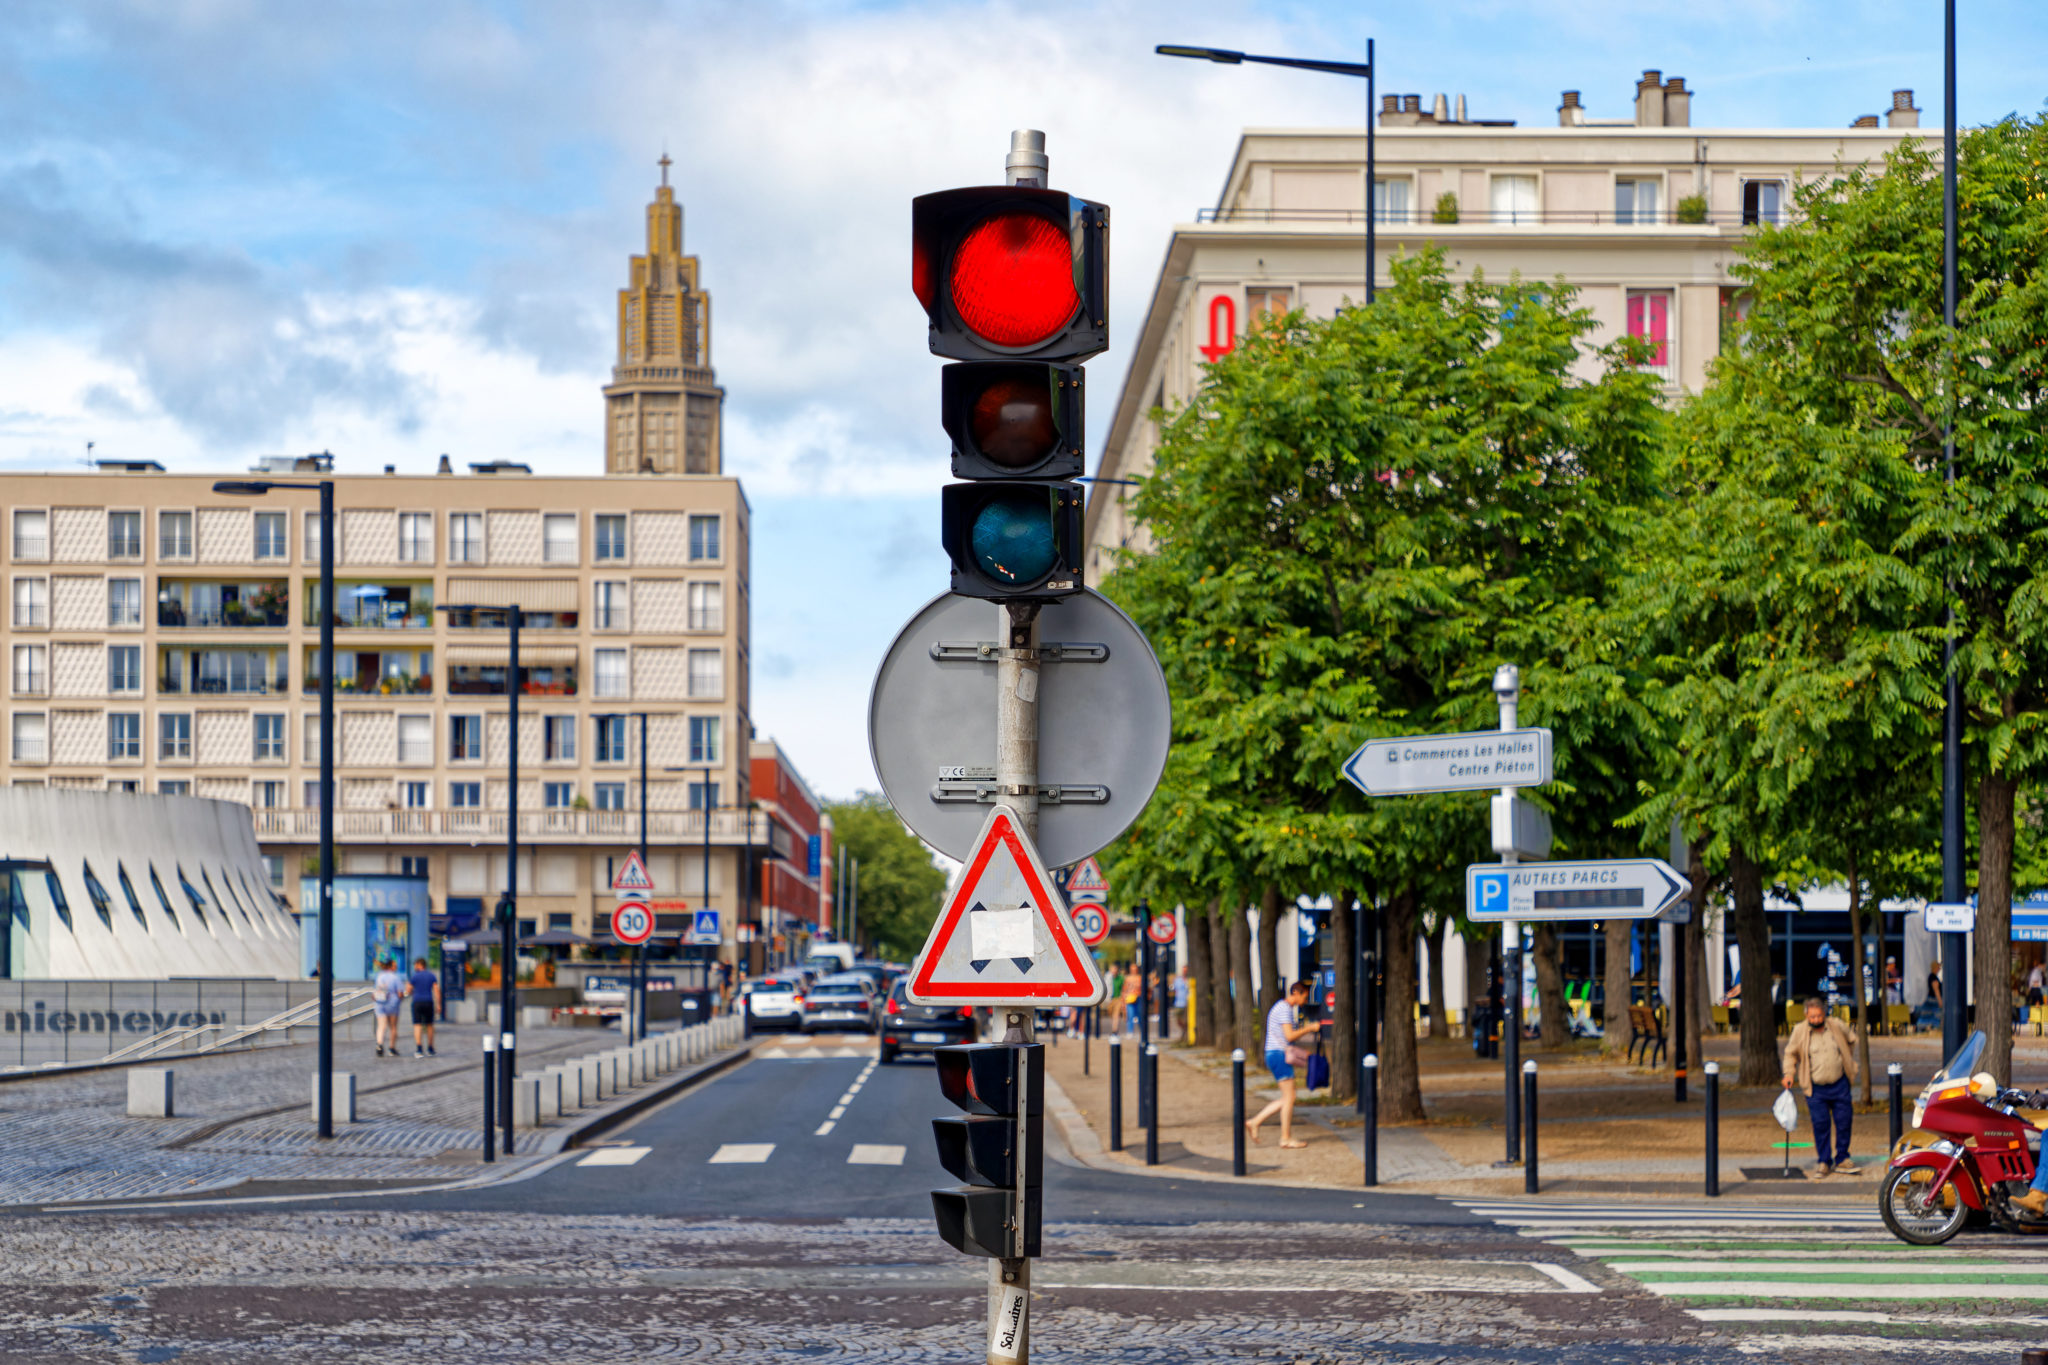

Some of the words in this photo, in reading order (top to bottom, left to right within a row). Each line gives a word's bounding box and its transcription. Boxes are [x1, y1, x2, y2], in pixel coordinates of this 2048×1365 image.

[1404, 747, 1470, 761] Commerces
[1473, 745, 1493, 757] Les
[1497, 742, 1534, 755] Halles
[952, 767, 965, 776] CE
[1448, 763, 1490, 777] Centre
[1494, 760, 1535, 774] Piéton
[1512, 871, 1567, 886] AUTRES
[1571, 870, 1619, 884] PARCS
[1482, 879, 1501, 907] P
[622, 914, 645, 931] 30
[1077, 915, 1102, 933] 30
